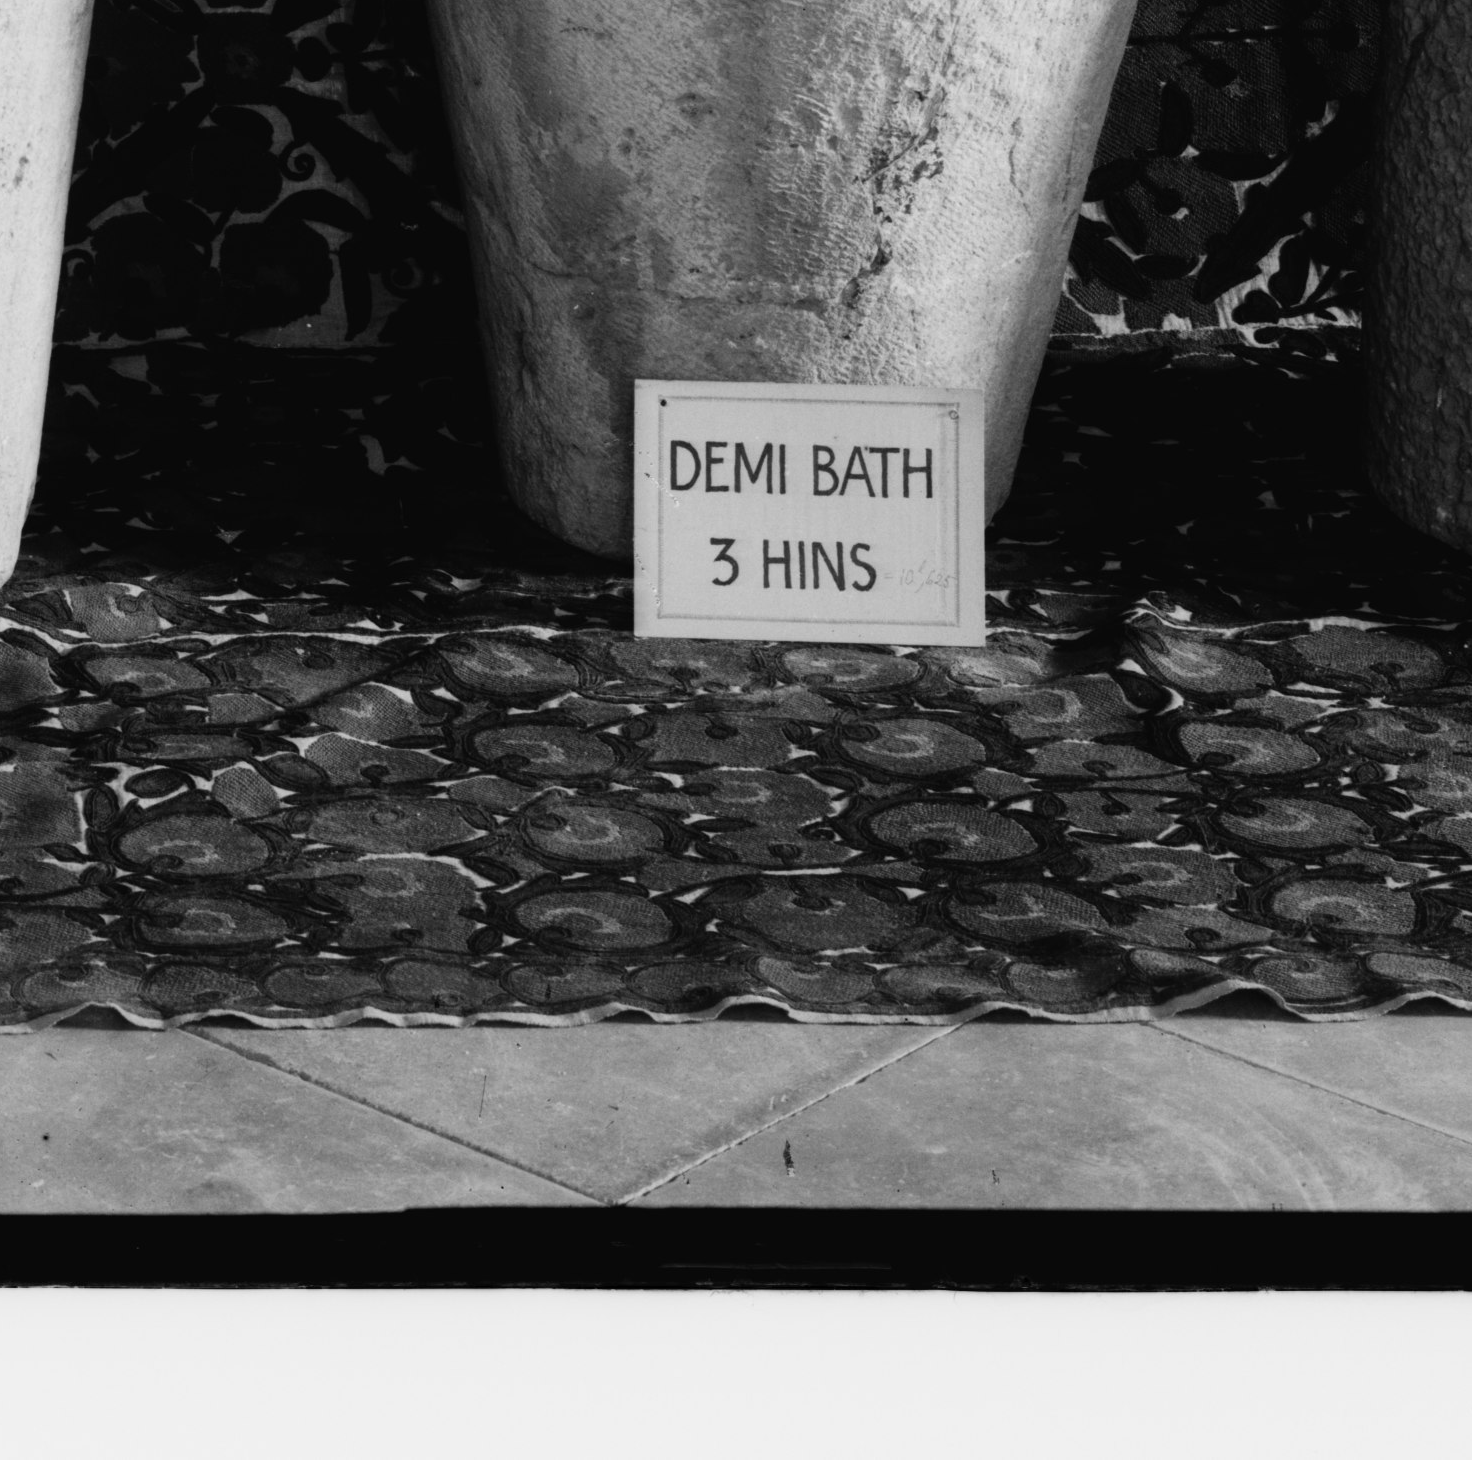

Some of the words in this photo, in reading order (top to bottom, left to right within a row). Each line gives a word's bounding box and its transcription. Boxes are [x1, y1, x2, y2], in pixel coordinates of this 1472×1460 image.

[671, 441, 786, 494] DEMI
[813, 445, 932, 498] BATH
[710, 538, 739, 586] 3
[763, 540, 876, 591] HINS
